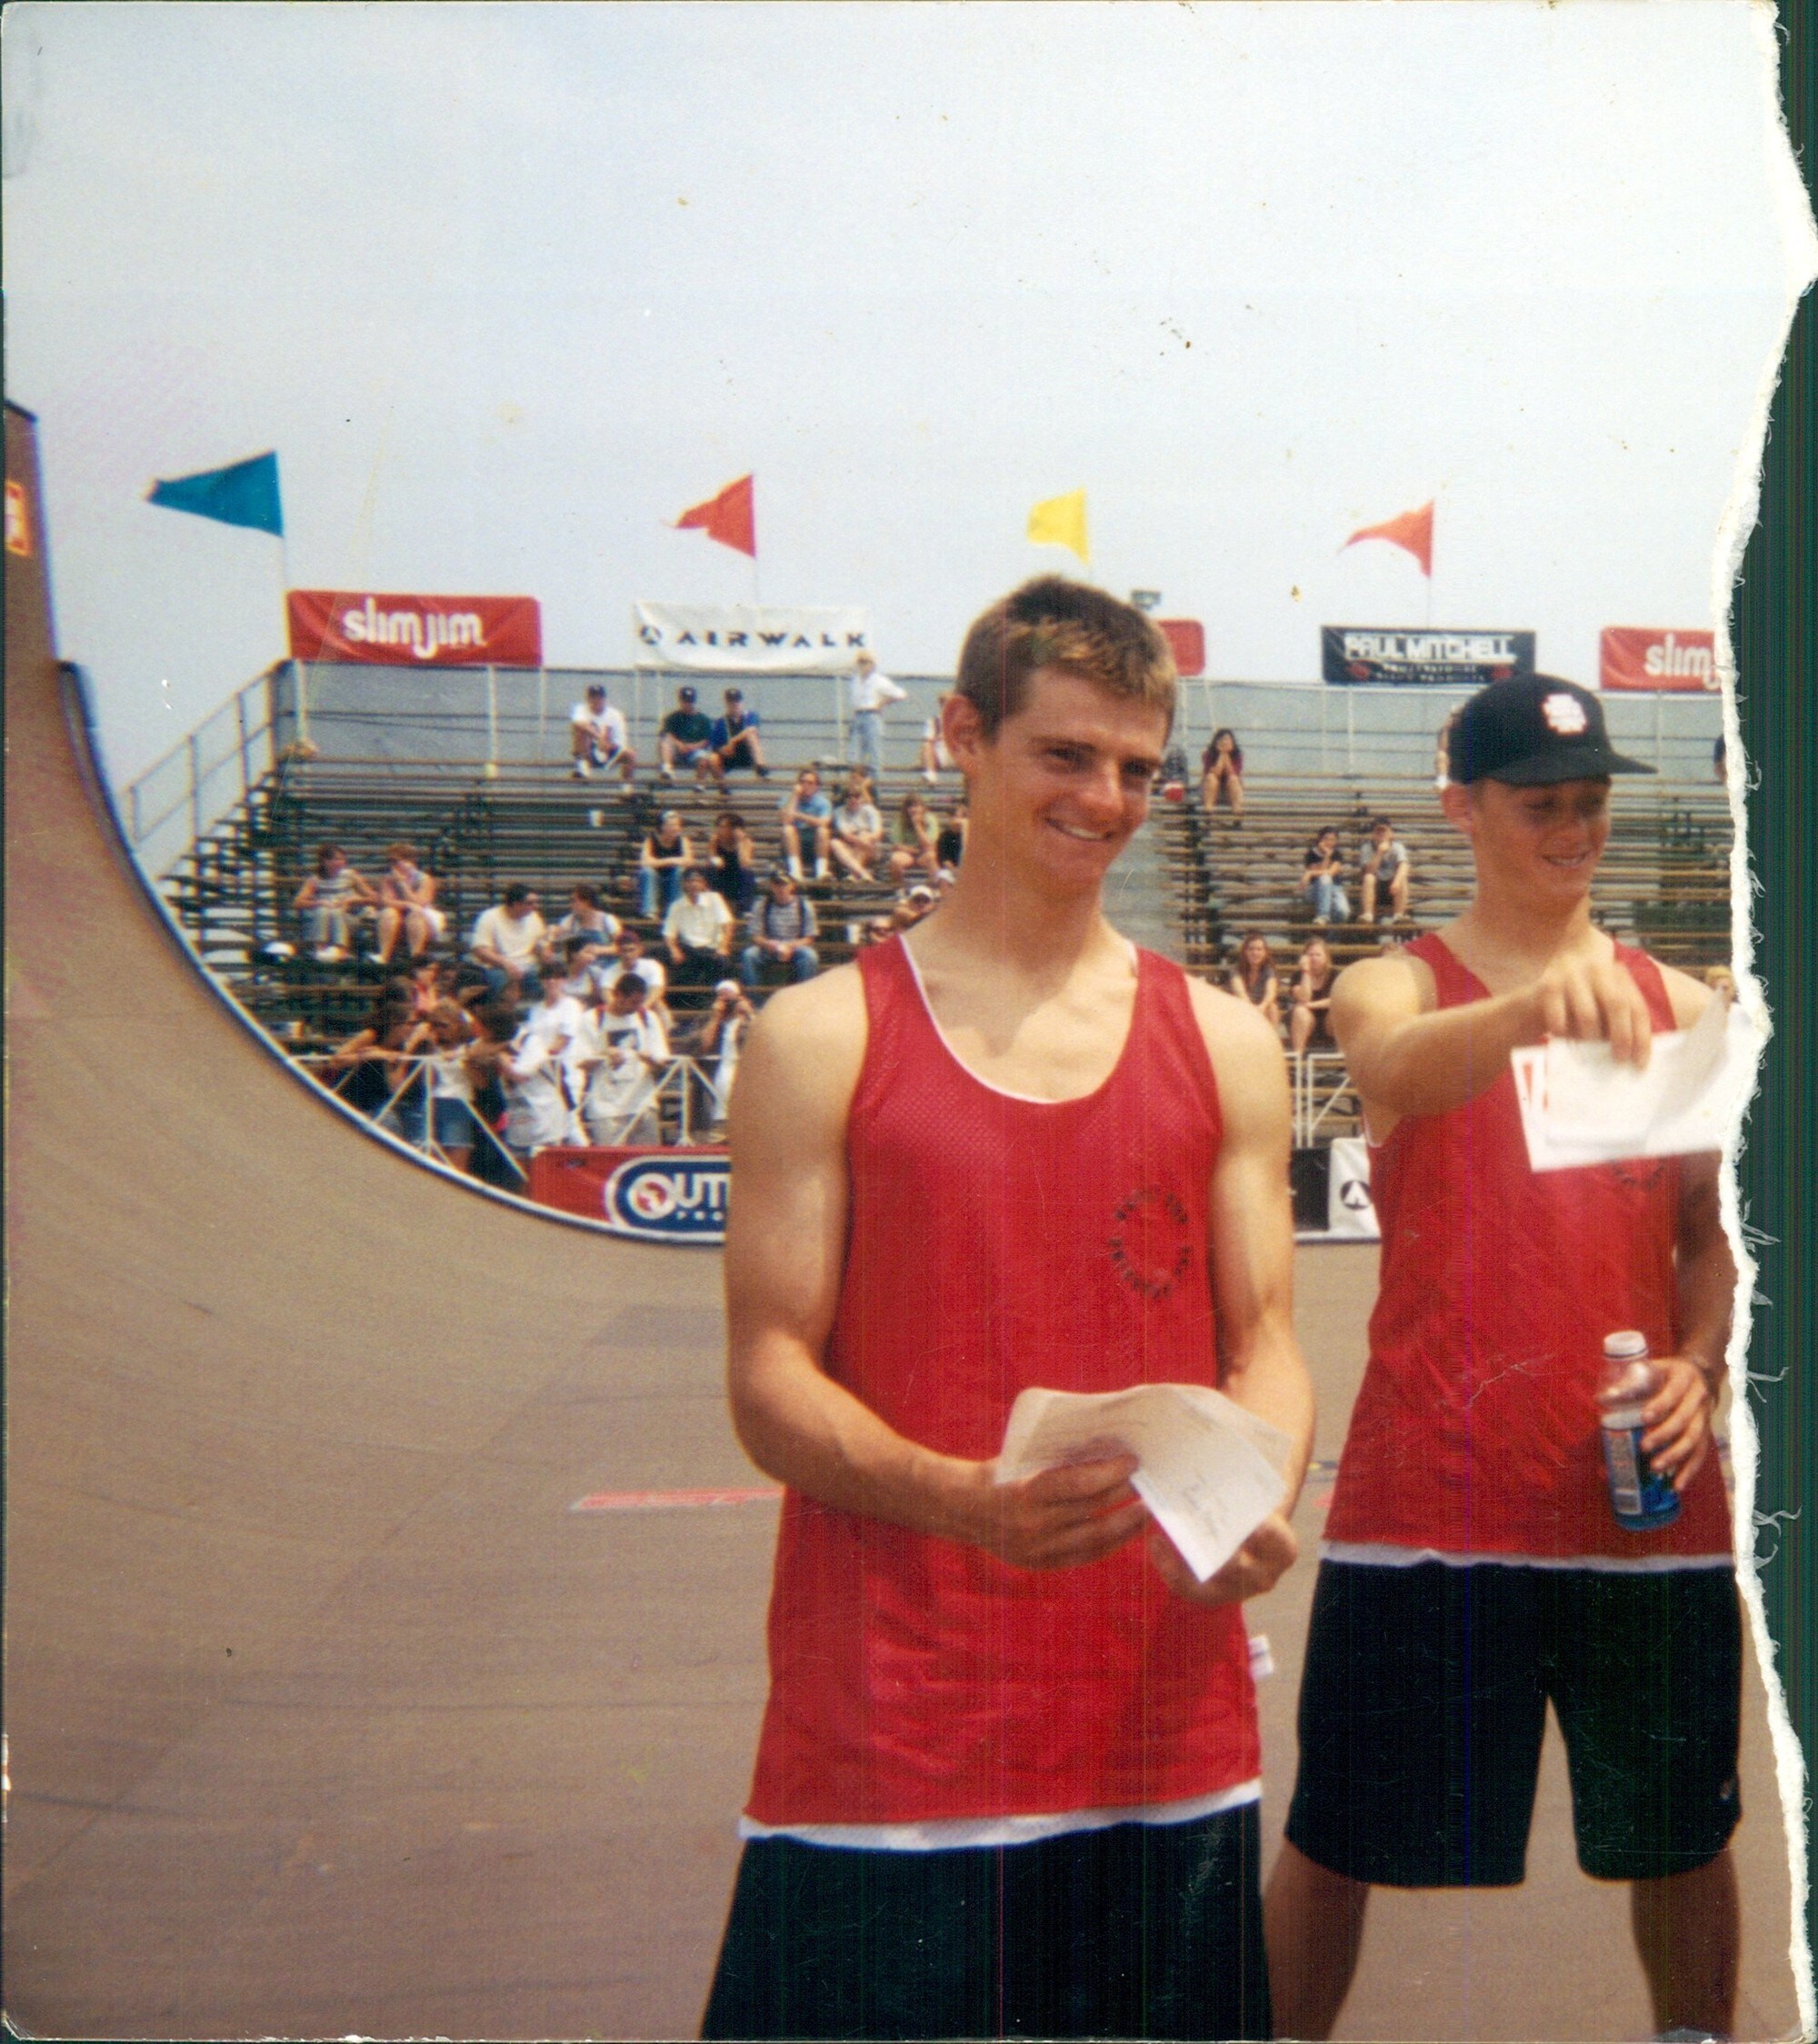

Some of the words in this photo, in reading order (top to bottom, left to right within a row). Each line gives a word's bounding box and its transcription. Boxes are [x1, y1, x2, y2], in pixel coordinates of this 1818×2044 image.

[676, 631, 865, 648] AIRWALK
[1344, 632, 1407, 661] PAUL
[1408, 633, 1519, 663] MITCHELL
[627, 1172, 731, 1220] OUT
